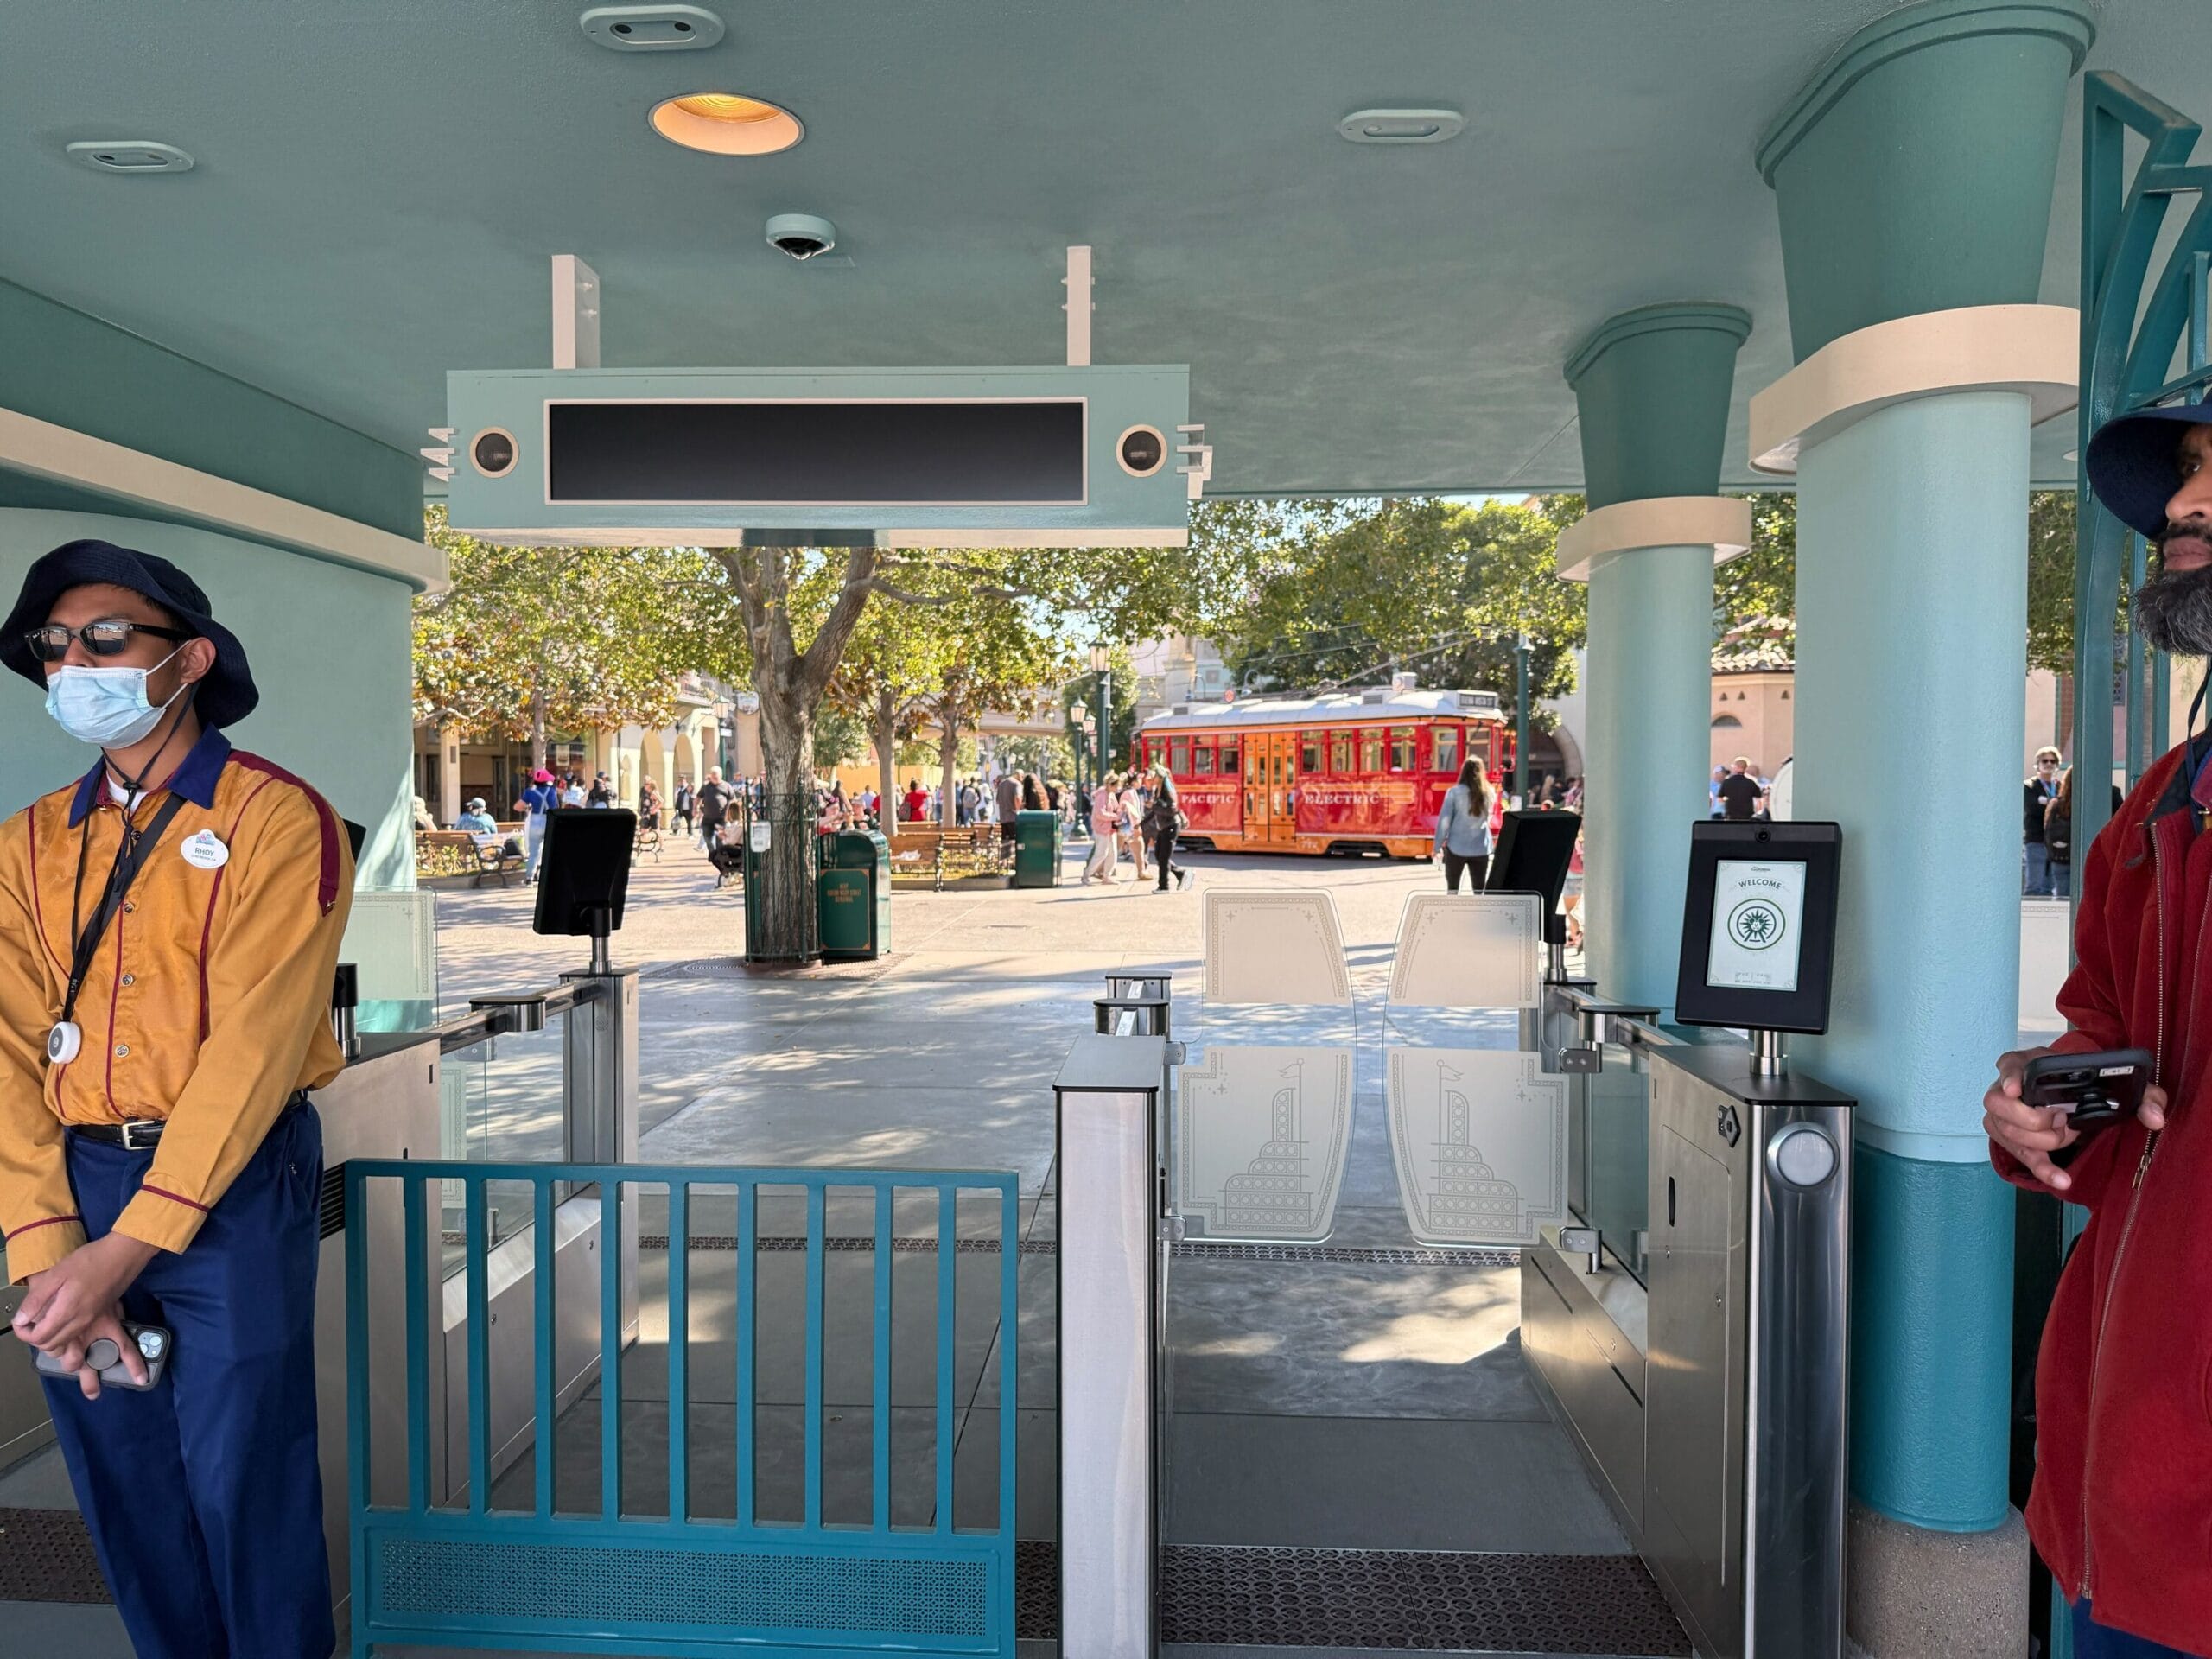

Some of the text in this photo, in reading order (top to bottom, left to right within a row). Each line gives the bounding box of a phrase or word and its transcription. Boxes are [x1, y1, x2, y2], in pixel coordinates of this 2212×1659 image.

[1182, 795, 1380, 804] PACIFIC ELECTRIC
[194, 847, 214, 857] RHOY
[1738, 879, 1782, 889] WELCOME
